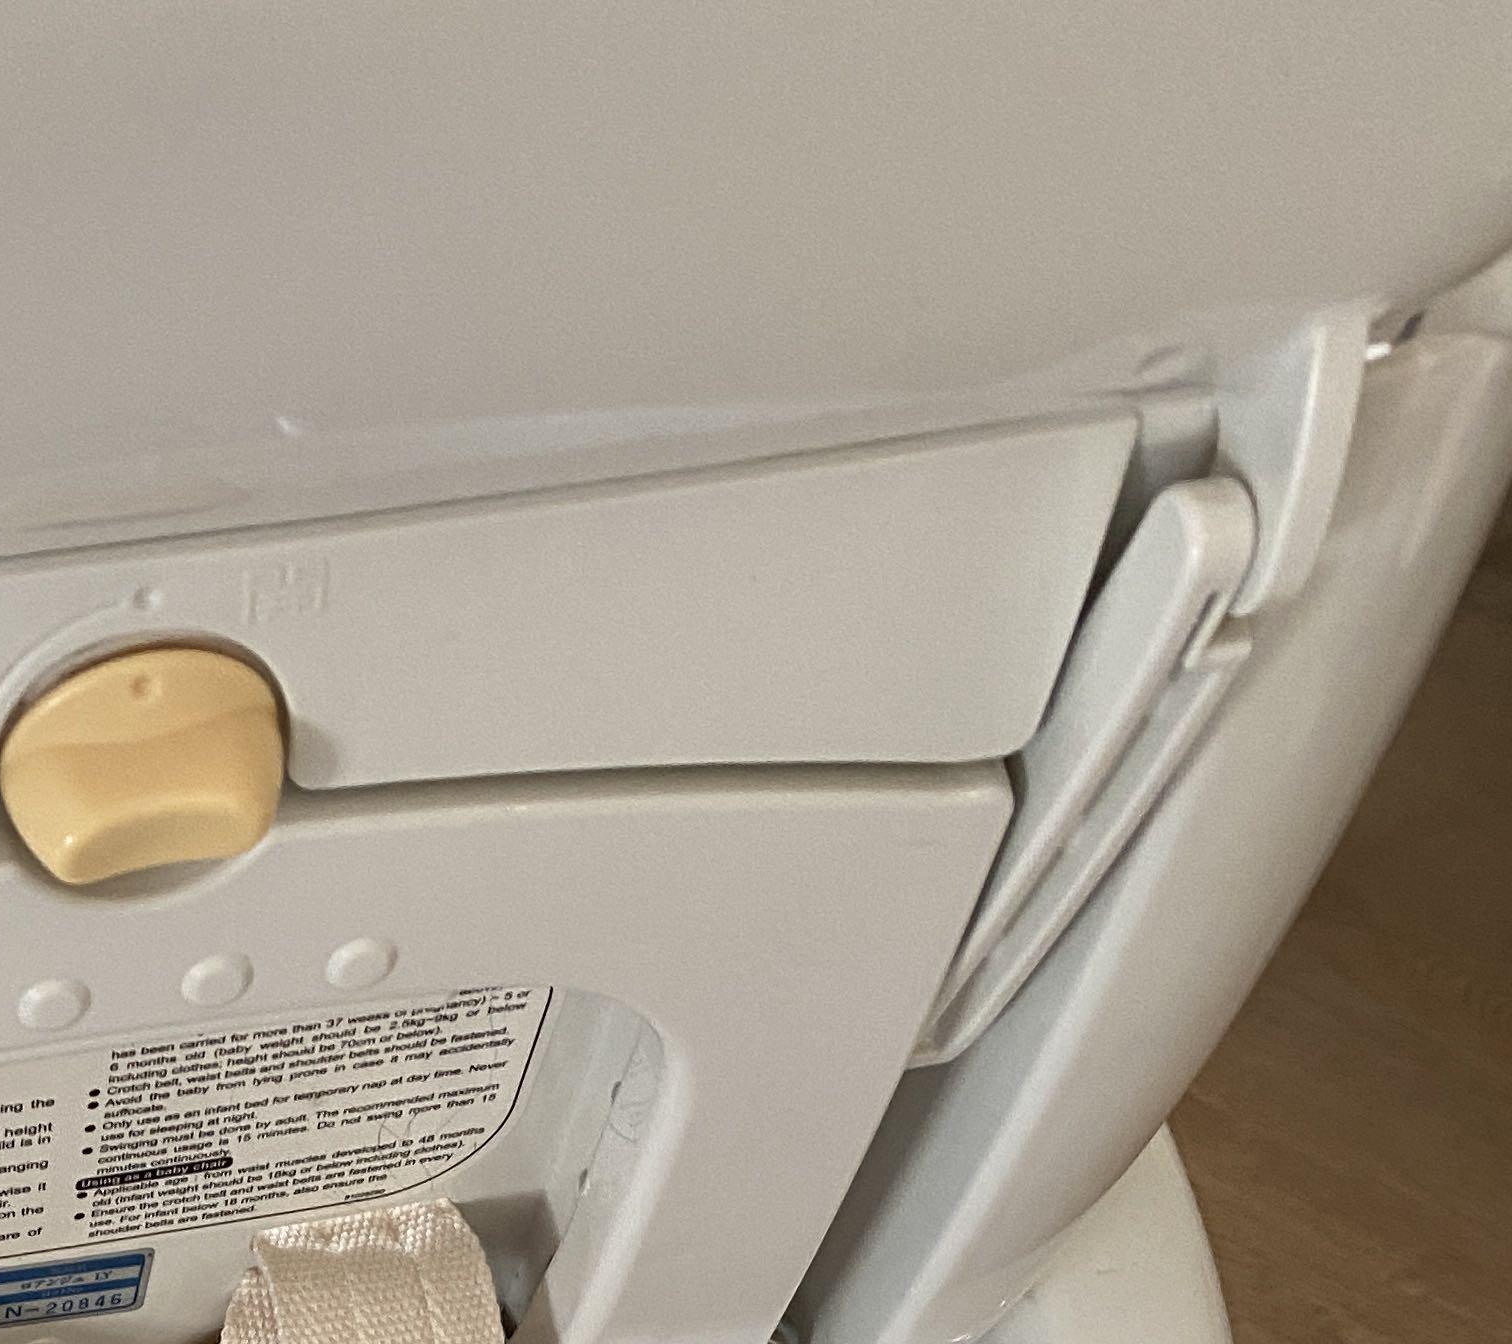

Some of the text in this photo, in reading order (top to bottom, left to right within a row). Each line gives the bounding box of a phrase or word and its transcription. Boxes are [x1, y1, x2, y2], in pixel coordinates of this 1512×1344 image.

[30, 1098, 55, 1109] the
[3, 1122, 53, 1138] height
[20, 1138, 33, 1147] is
[37, 1134, 51, 1145] in
[37, 1182, 46, 1192] it
[20, 1206, 44, 1217] the
[27, 1226, 43, 1237] of
